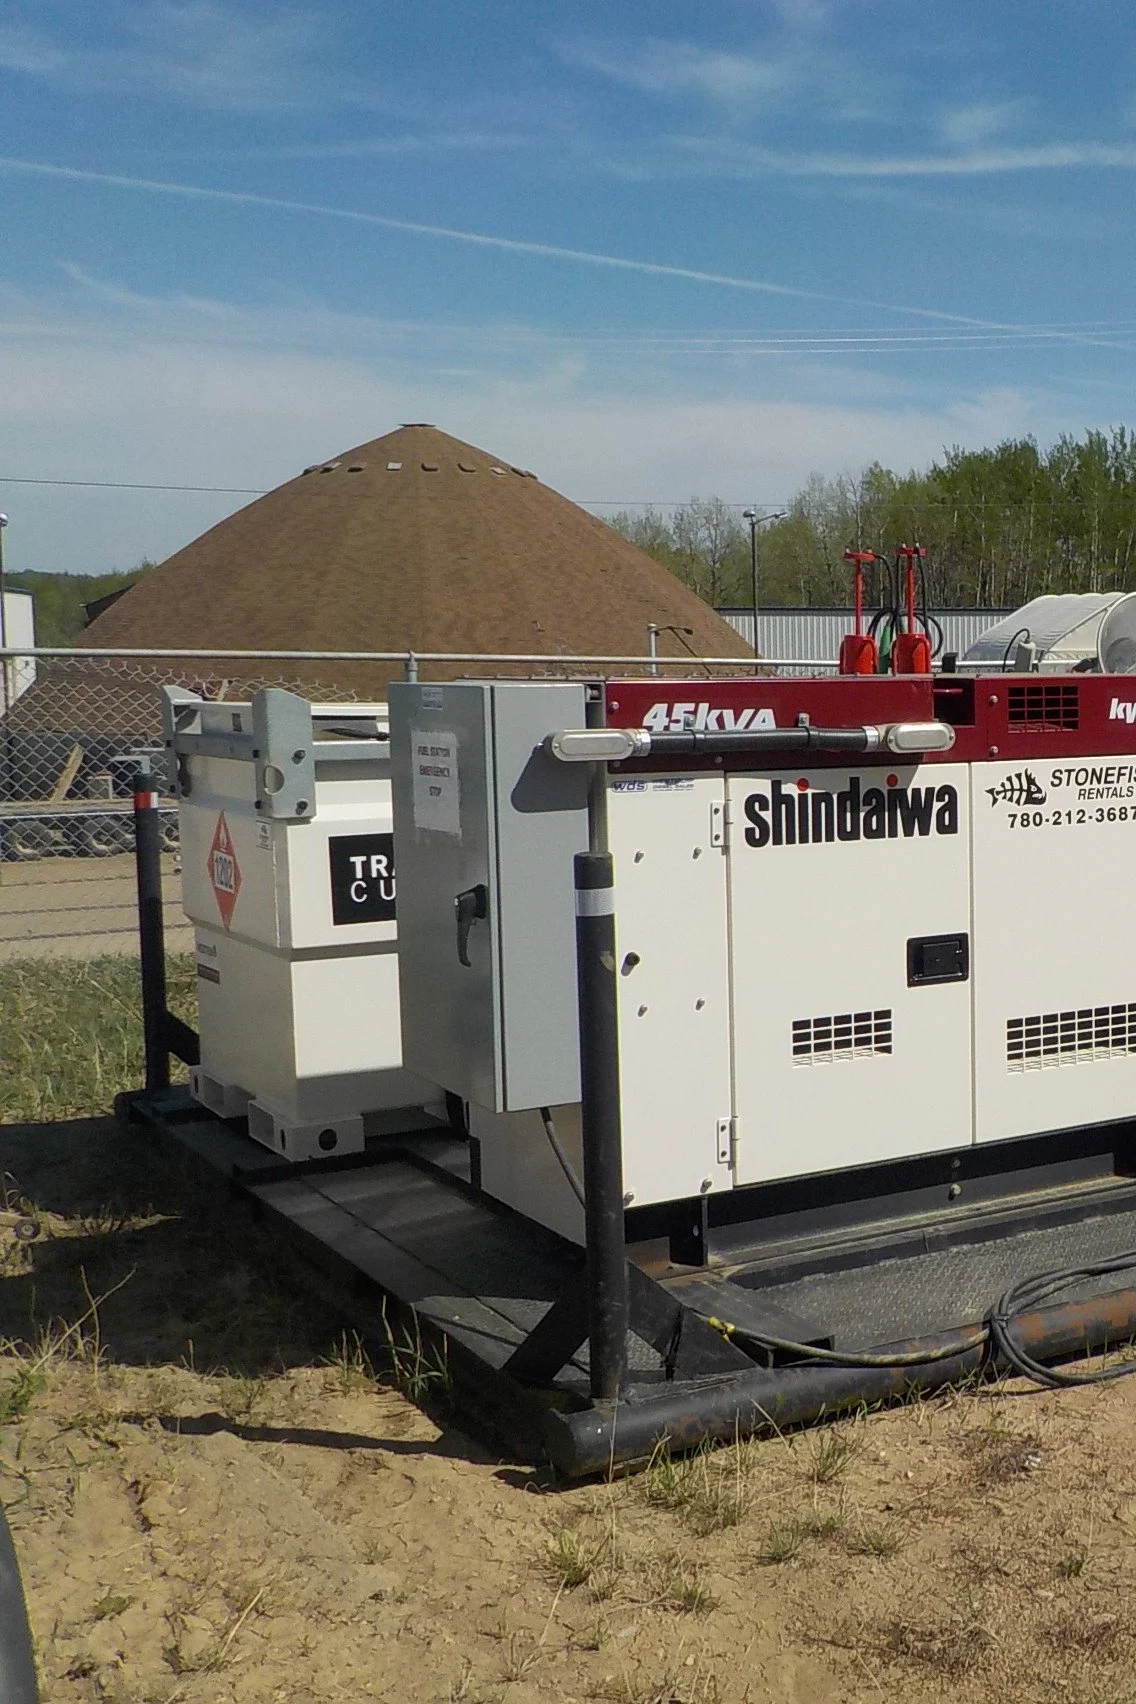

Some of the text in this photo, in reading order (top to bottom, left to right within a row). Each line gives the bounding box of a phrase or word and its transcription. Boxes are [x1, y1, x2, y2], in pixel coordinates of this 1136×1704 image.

[613, 780, 646, 791] wds
[1078, 785, 1134, 800] RENTALS
[744, 773, 958, 848] shindaiwa
[350, 855, 395, 879] TR
